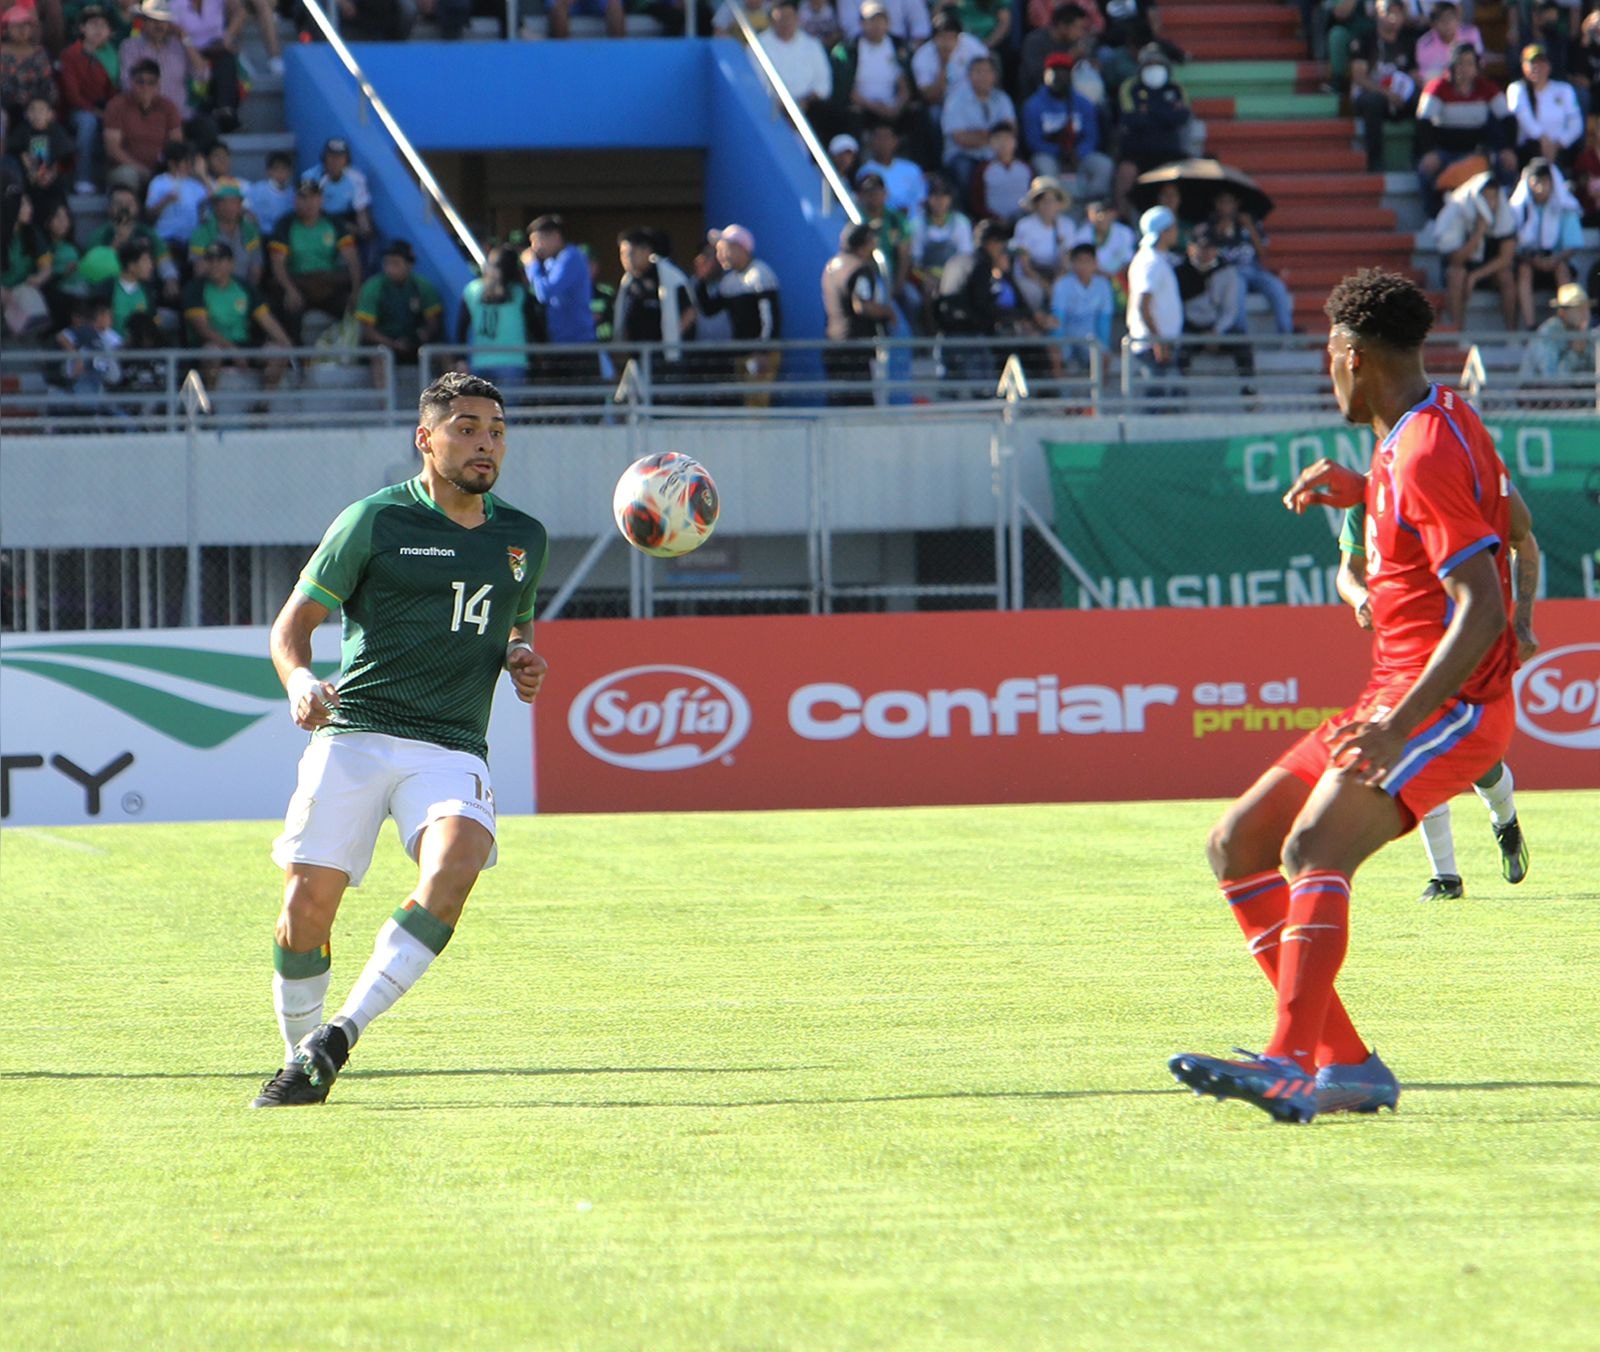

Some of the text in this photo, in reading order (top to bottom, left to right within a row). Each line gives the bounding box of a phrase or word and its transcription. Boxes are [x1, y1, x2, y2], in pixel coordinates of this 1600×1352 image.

[399, 546, 456, 558] marathon
[450, 580, 494, 636] 14
[1166, 555, 1341, 608] SUEÑ
[592, 686, 730, 746] Sofía
[787, 673, 1179, 740] Confiar
[1192, 676, 1298, 706] es el
